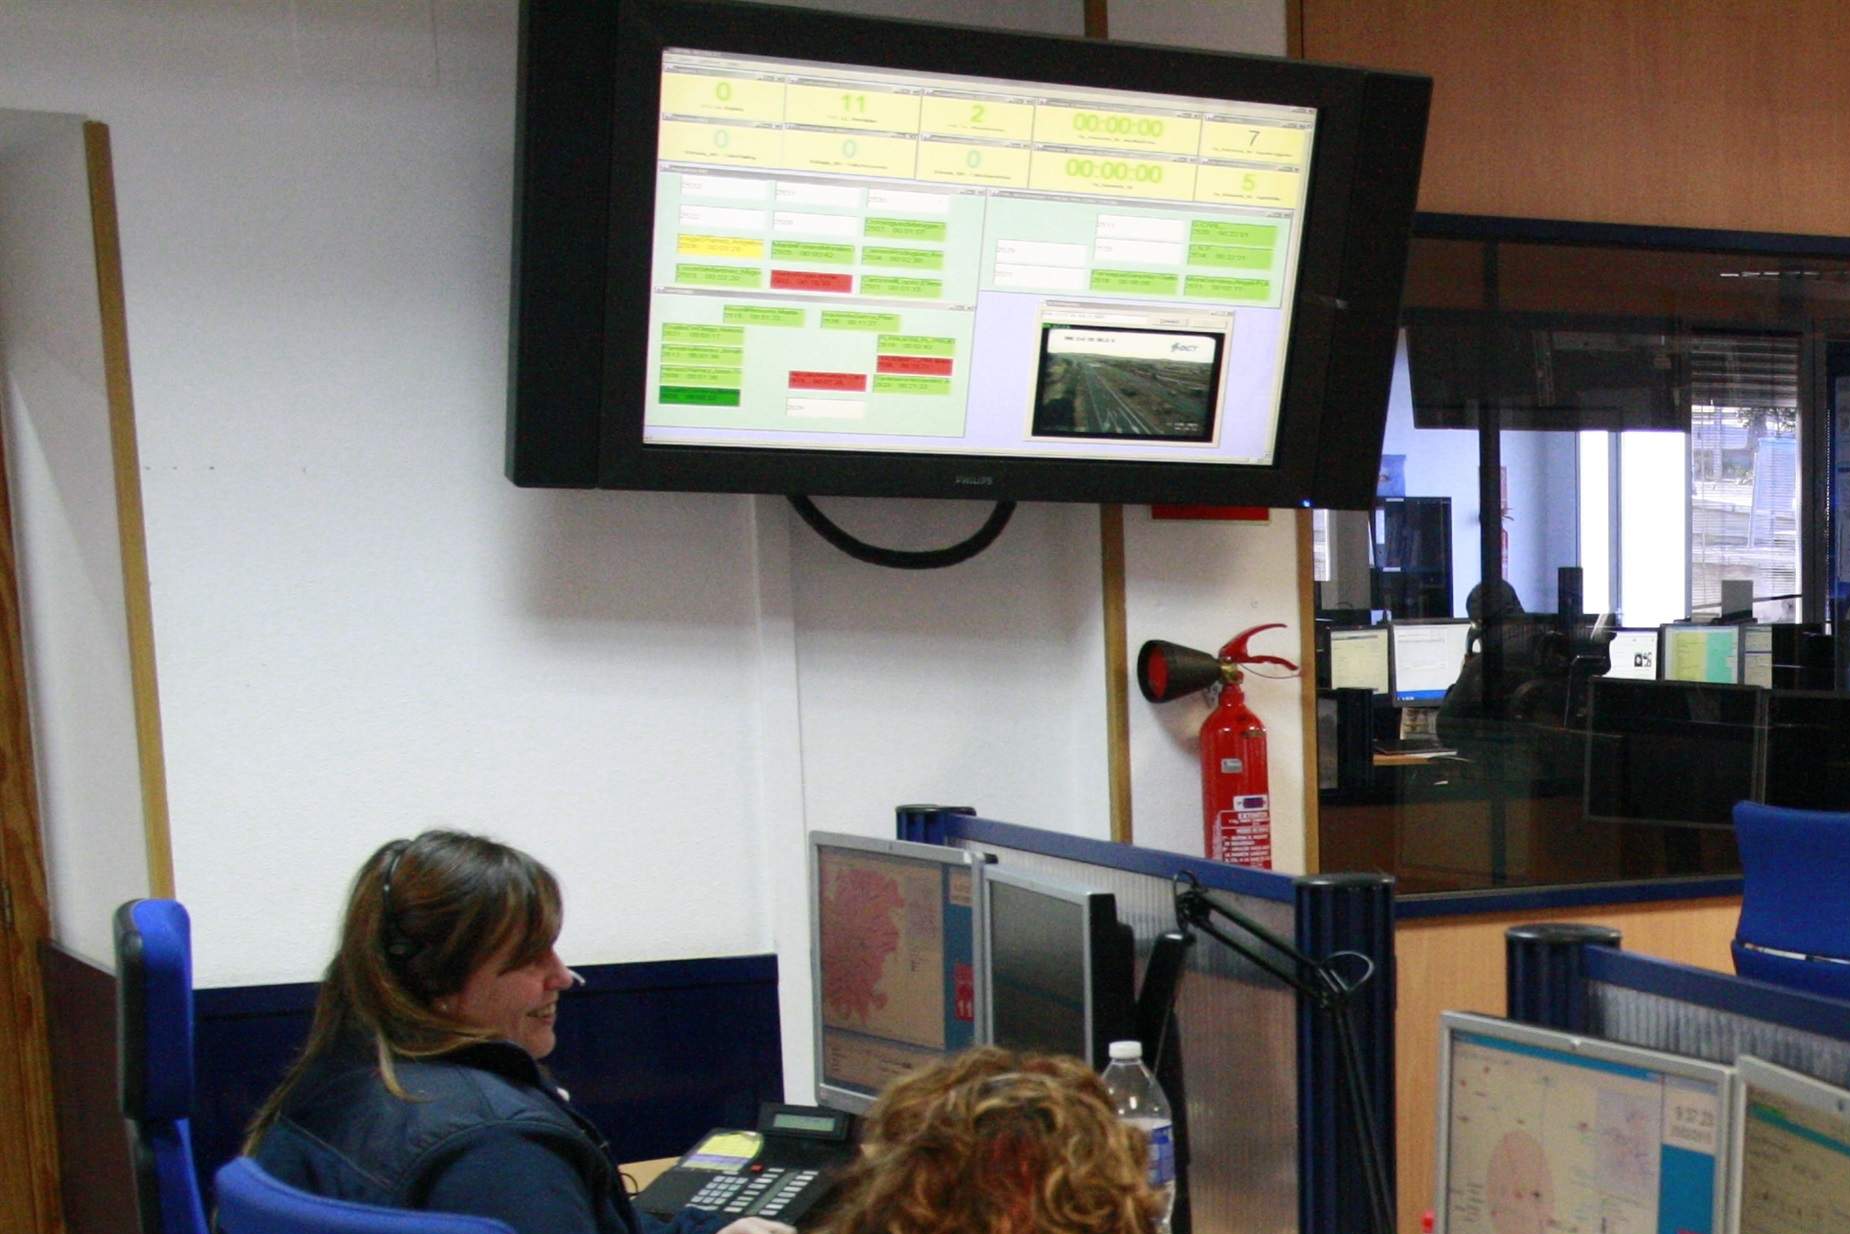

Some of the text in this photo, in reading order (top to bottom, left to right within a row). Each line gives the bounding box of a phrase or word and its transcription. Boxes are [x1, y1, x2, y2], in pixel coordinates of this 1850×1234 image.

[715, 81, 732, 102] 0
[841, 94, 867, 113] 11
[969, 104, 985, 123] 2
[1072, 112, 1164, 138] 00:00:00
[713, 128, 729, 149] 0
[1248, 129, 1261, 147] 7
[842, 138, 857, 159] 0
[966, 149, 982, 169] 0
[1065, 158, 1164, 184] 00:00:00
[1242, 173, 1256, 192] 5
